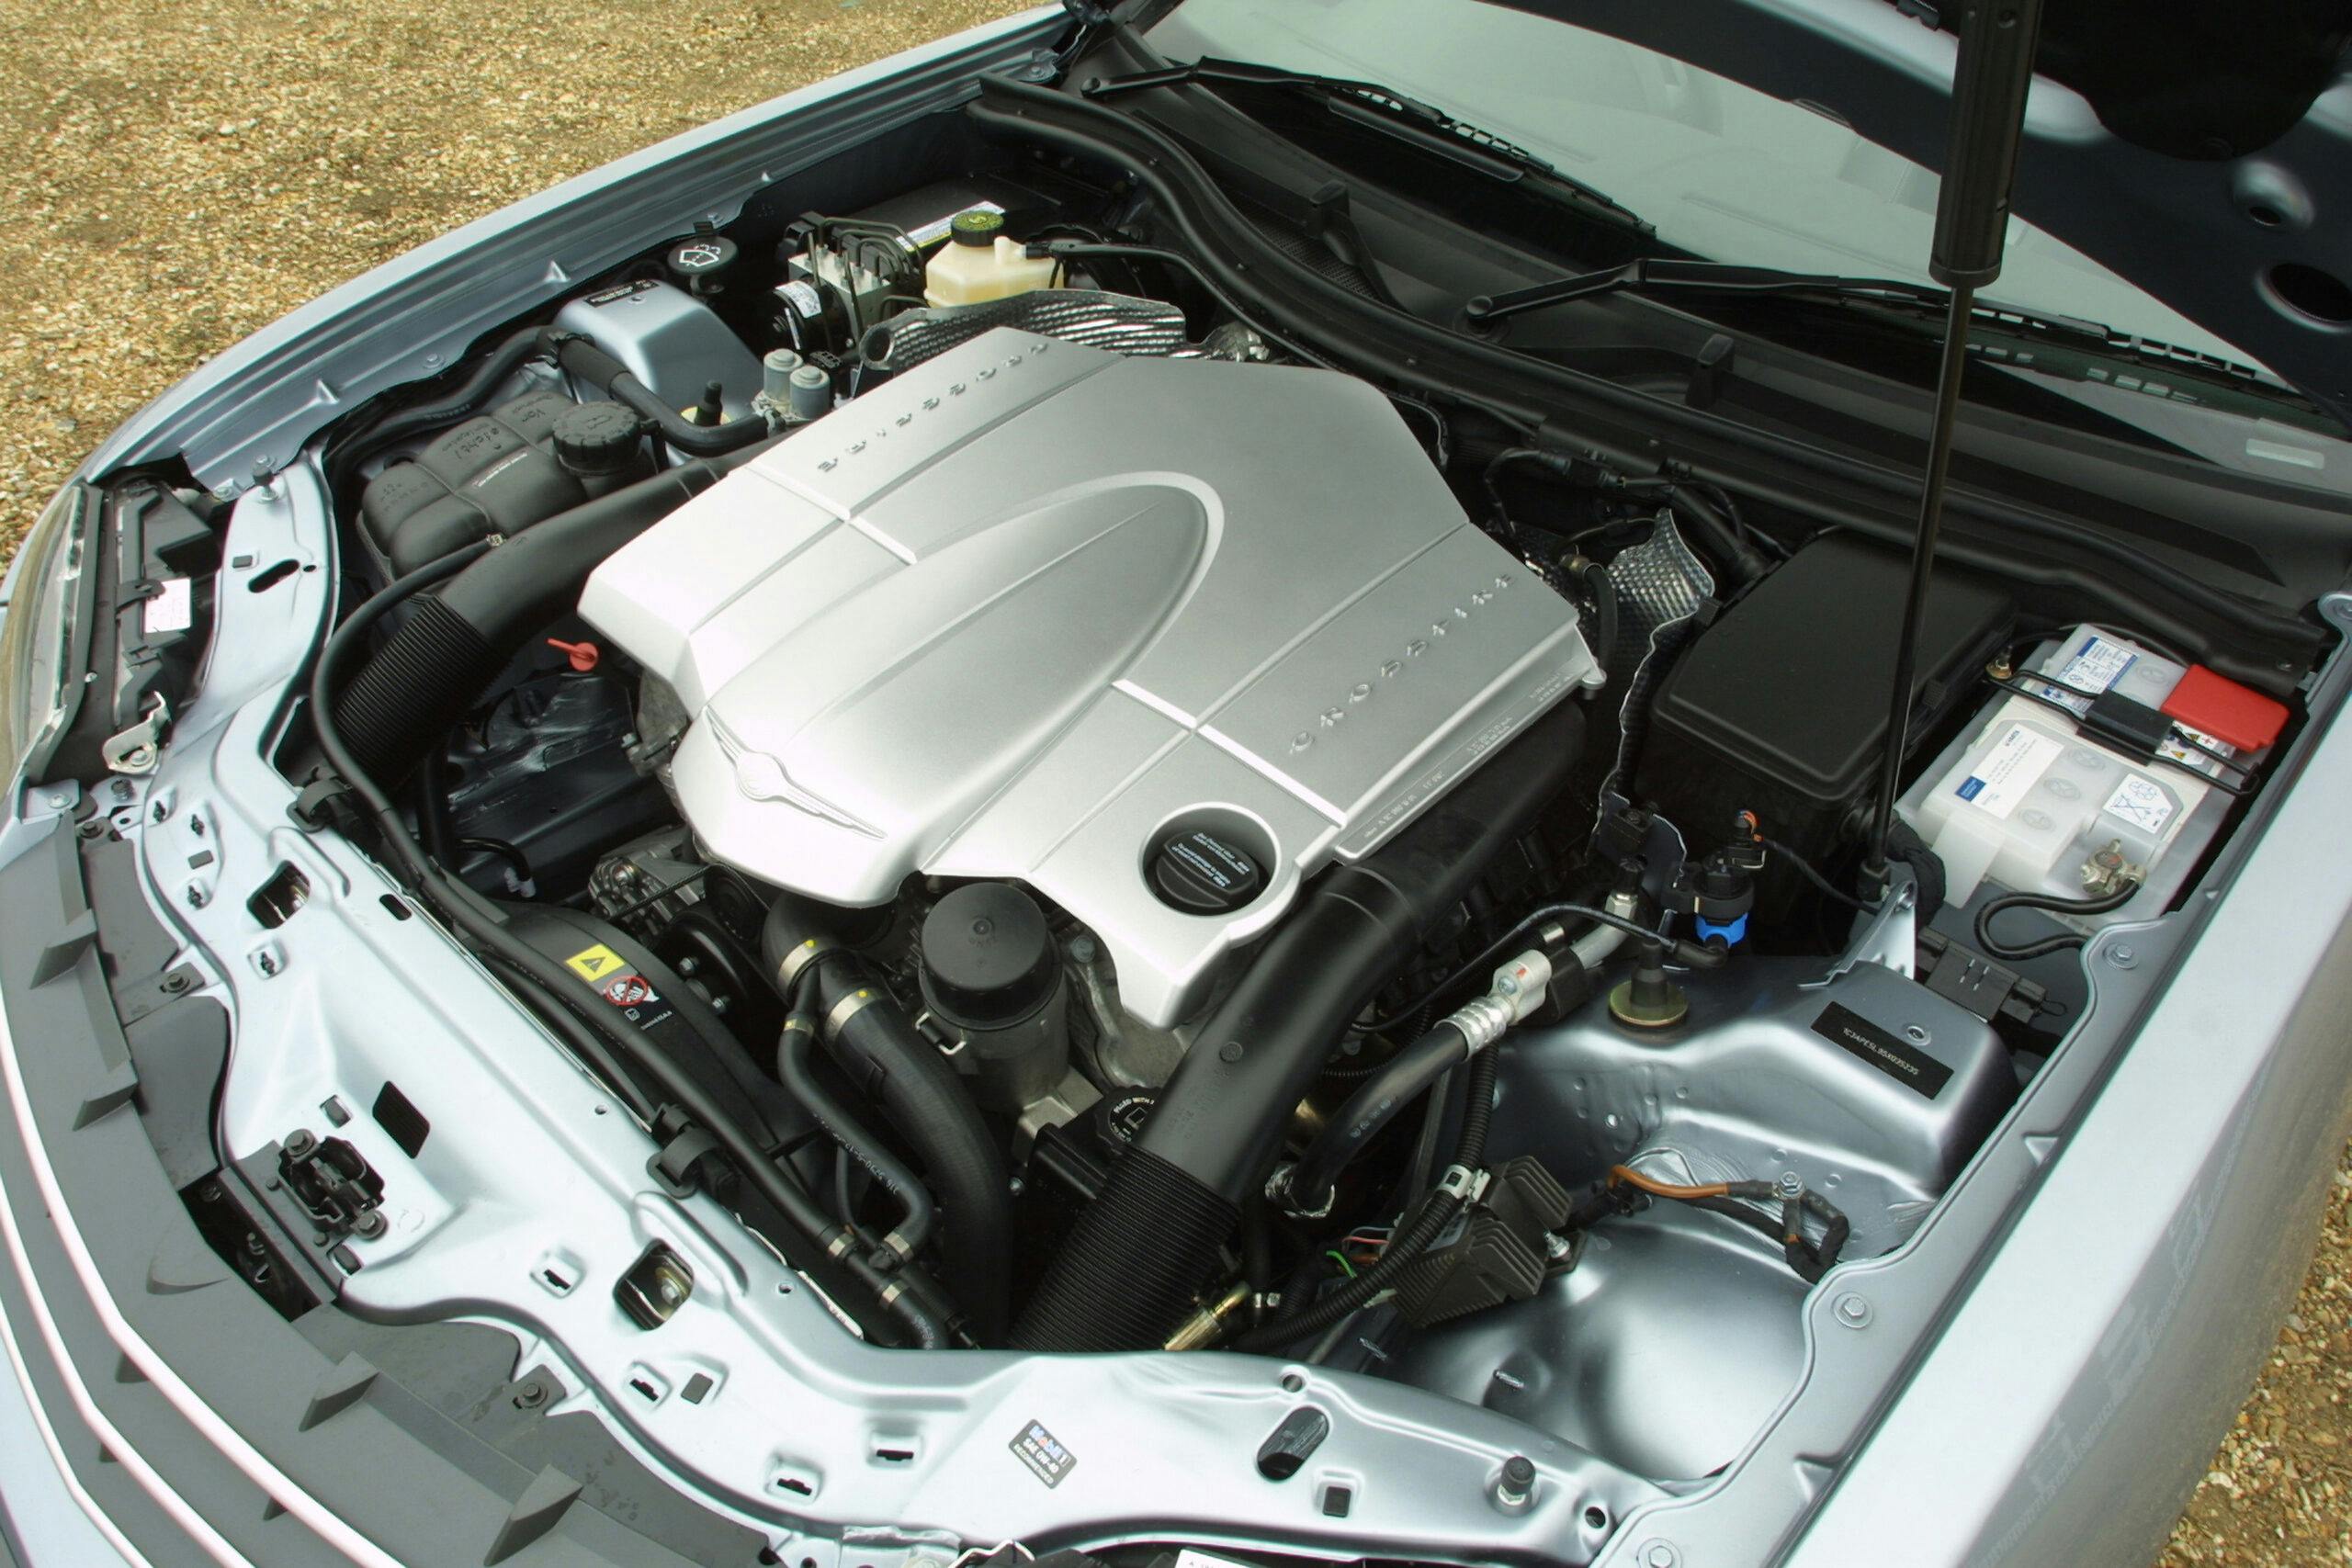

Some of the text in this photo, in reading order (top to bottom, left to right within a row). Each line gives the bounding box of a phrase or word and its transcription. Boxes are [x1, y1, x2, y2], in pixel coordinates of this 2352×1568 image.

[1288, 573, 1515, 754] CROSSFIRE
[1023, 1438, 1059, 1474] SAE 0W-40
[1029, 1425, 1062, 1459] Mobil
[1013, 1443, 1054, 1484] RECOMMENDED
